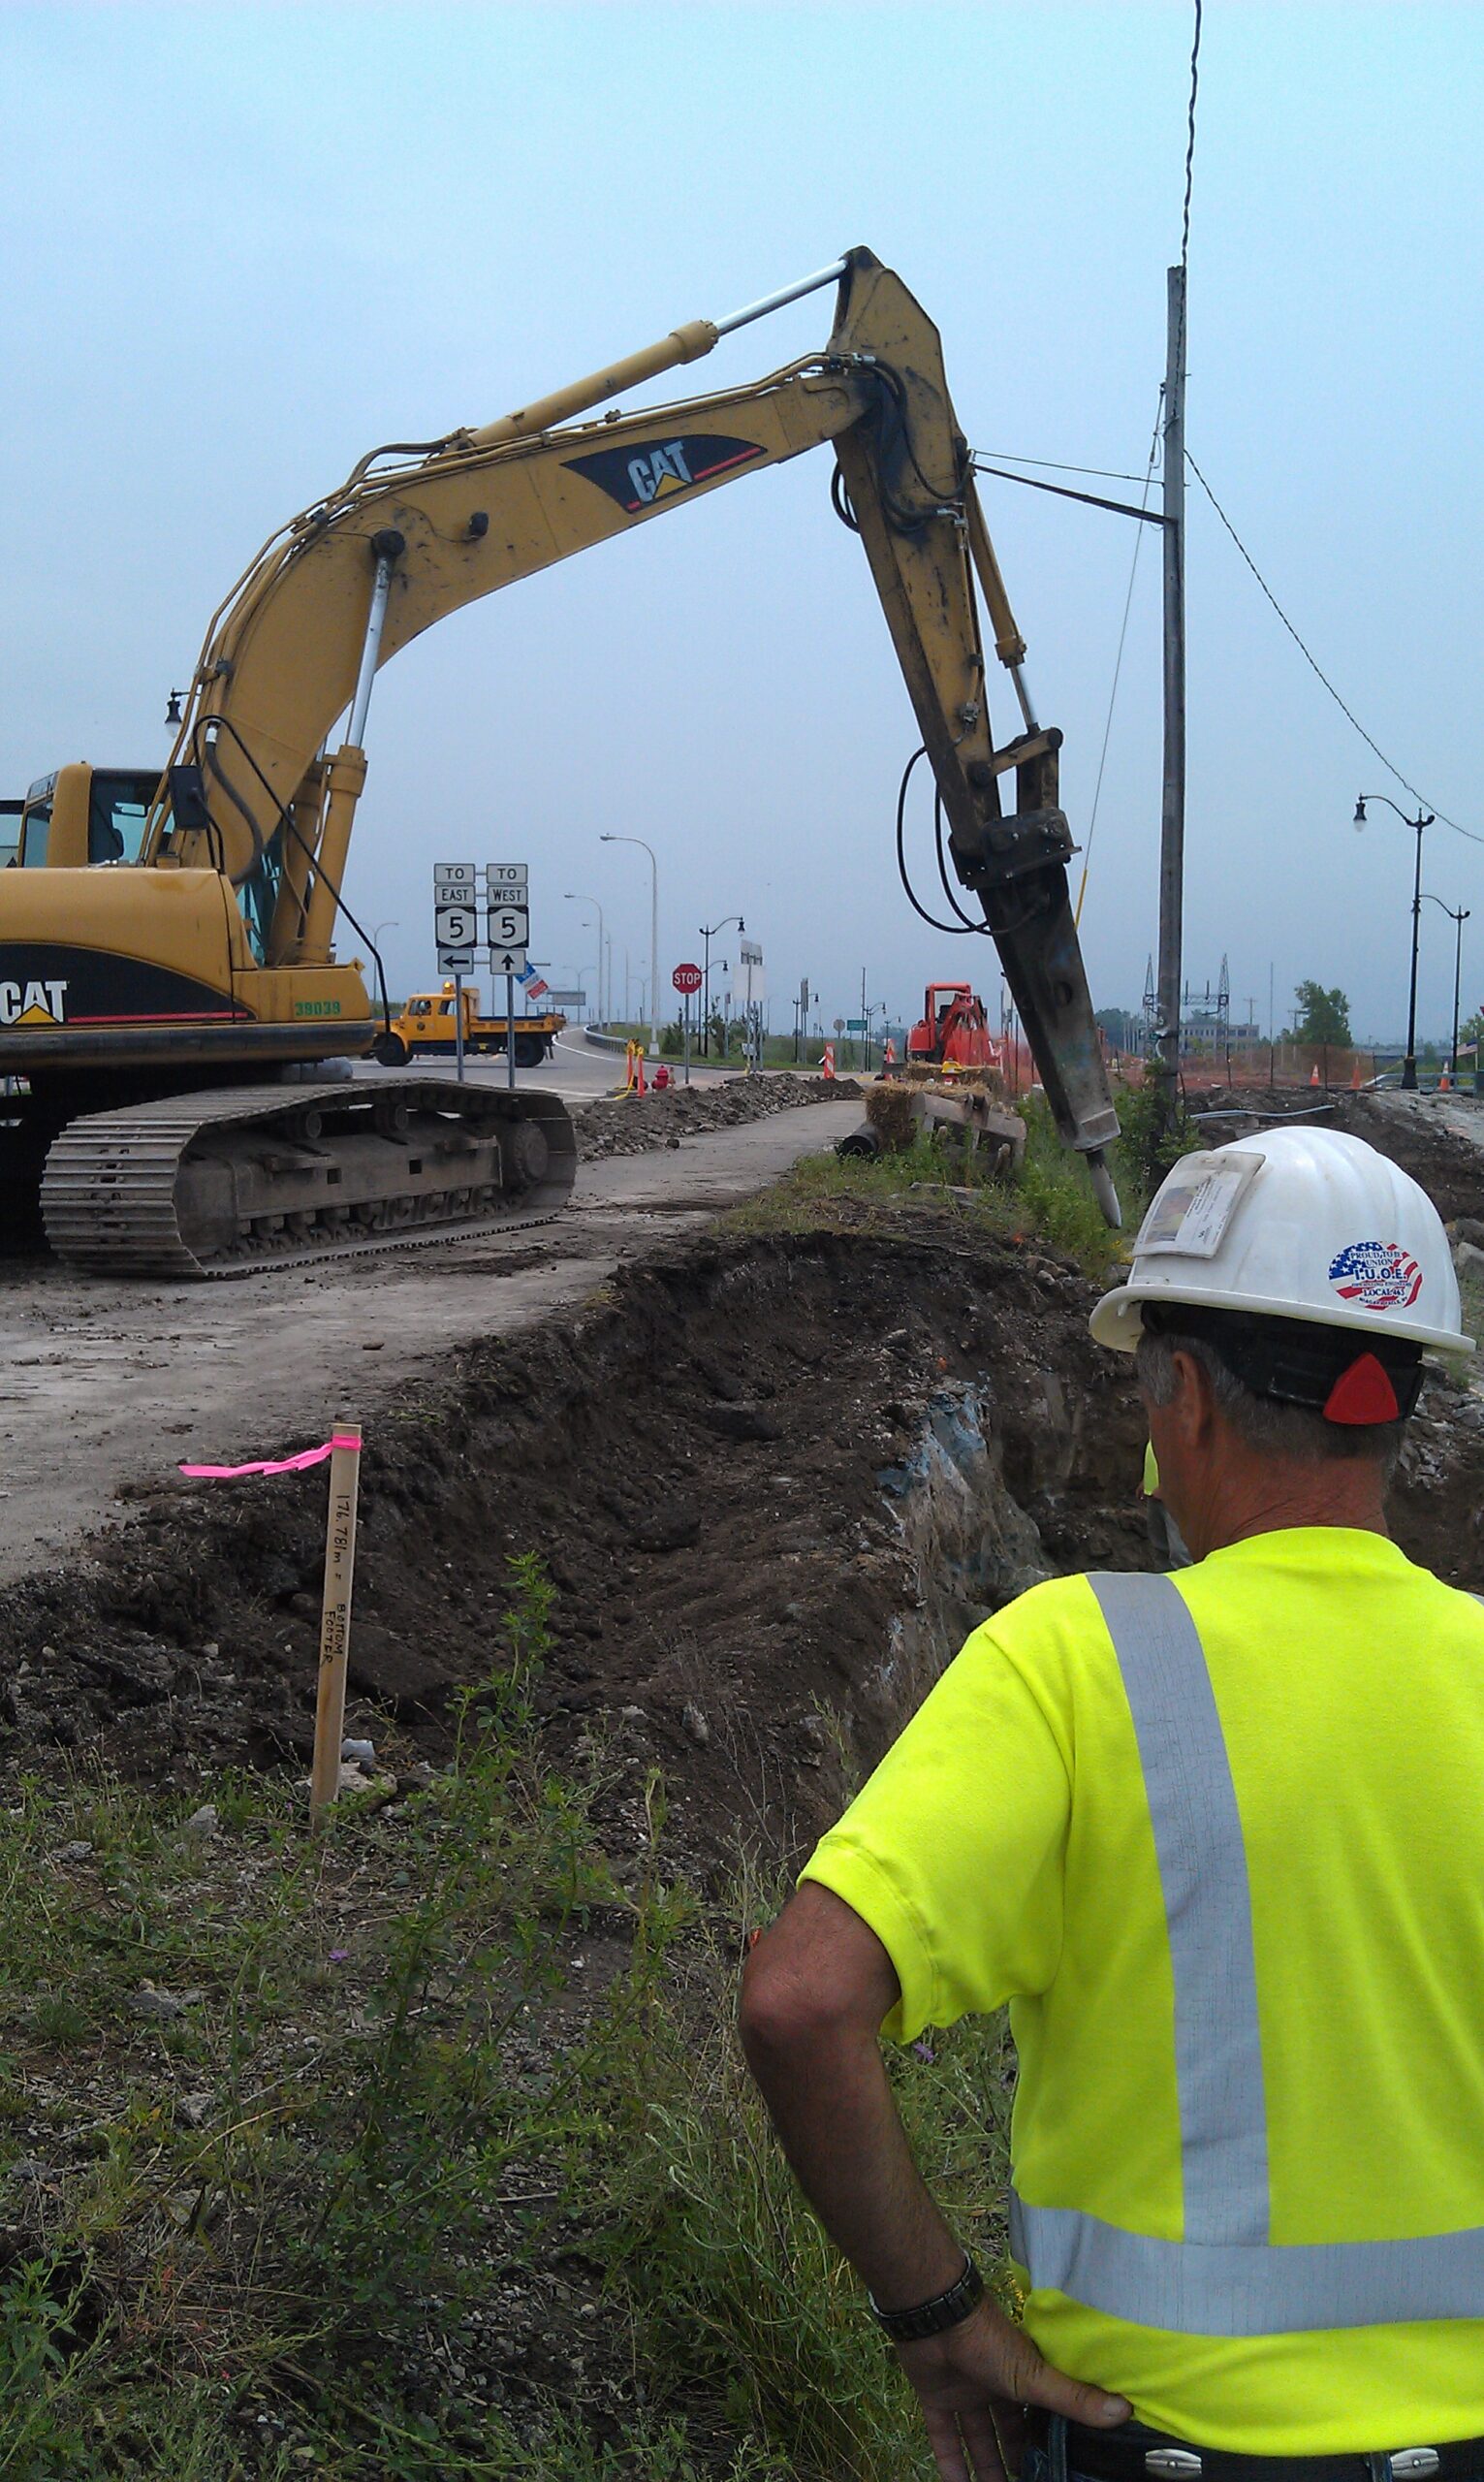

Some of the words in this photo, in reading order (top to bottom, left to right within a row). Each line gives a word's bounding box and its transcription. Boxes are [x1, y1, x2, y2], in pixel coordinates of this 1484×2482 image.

[627, 440, 692, 503] CAT
[445, 868, 464, 879] TO
[497, 868, 517, 879] TO
[441, 888, 468, 902] EAST
[492, 888, 521, 902] WEST
[450, 916, 464, 939] 5
[502, 916, 516, 939] 5
[674, 971, 702, 985] STOP
[0, 980, 68, 1026] CAT
[1350, 1251, 1380, 1259] PROUD
[1366, 1258, 1393, 1267] UNION
[1364, 1288, 1391, 1297] LOCAL
[333, 1604, 347, 1656] BOTTOM
[321, 1609, 337, 1668] FOOTER
